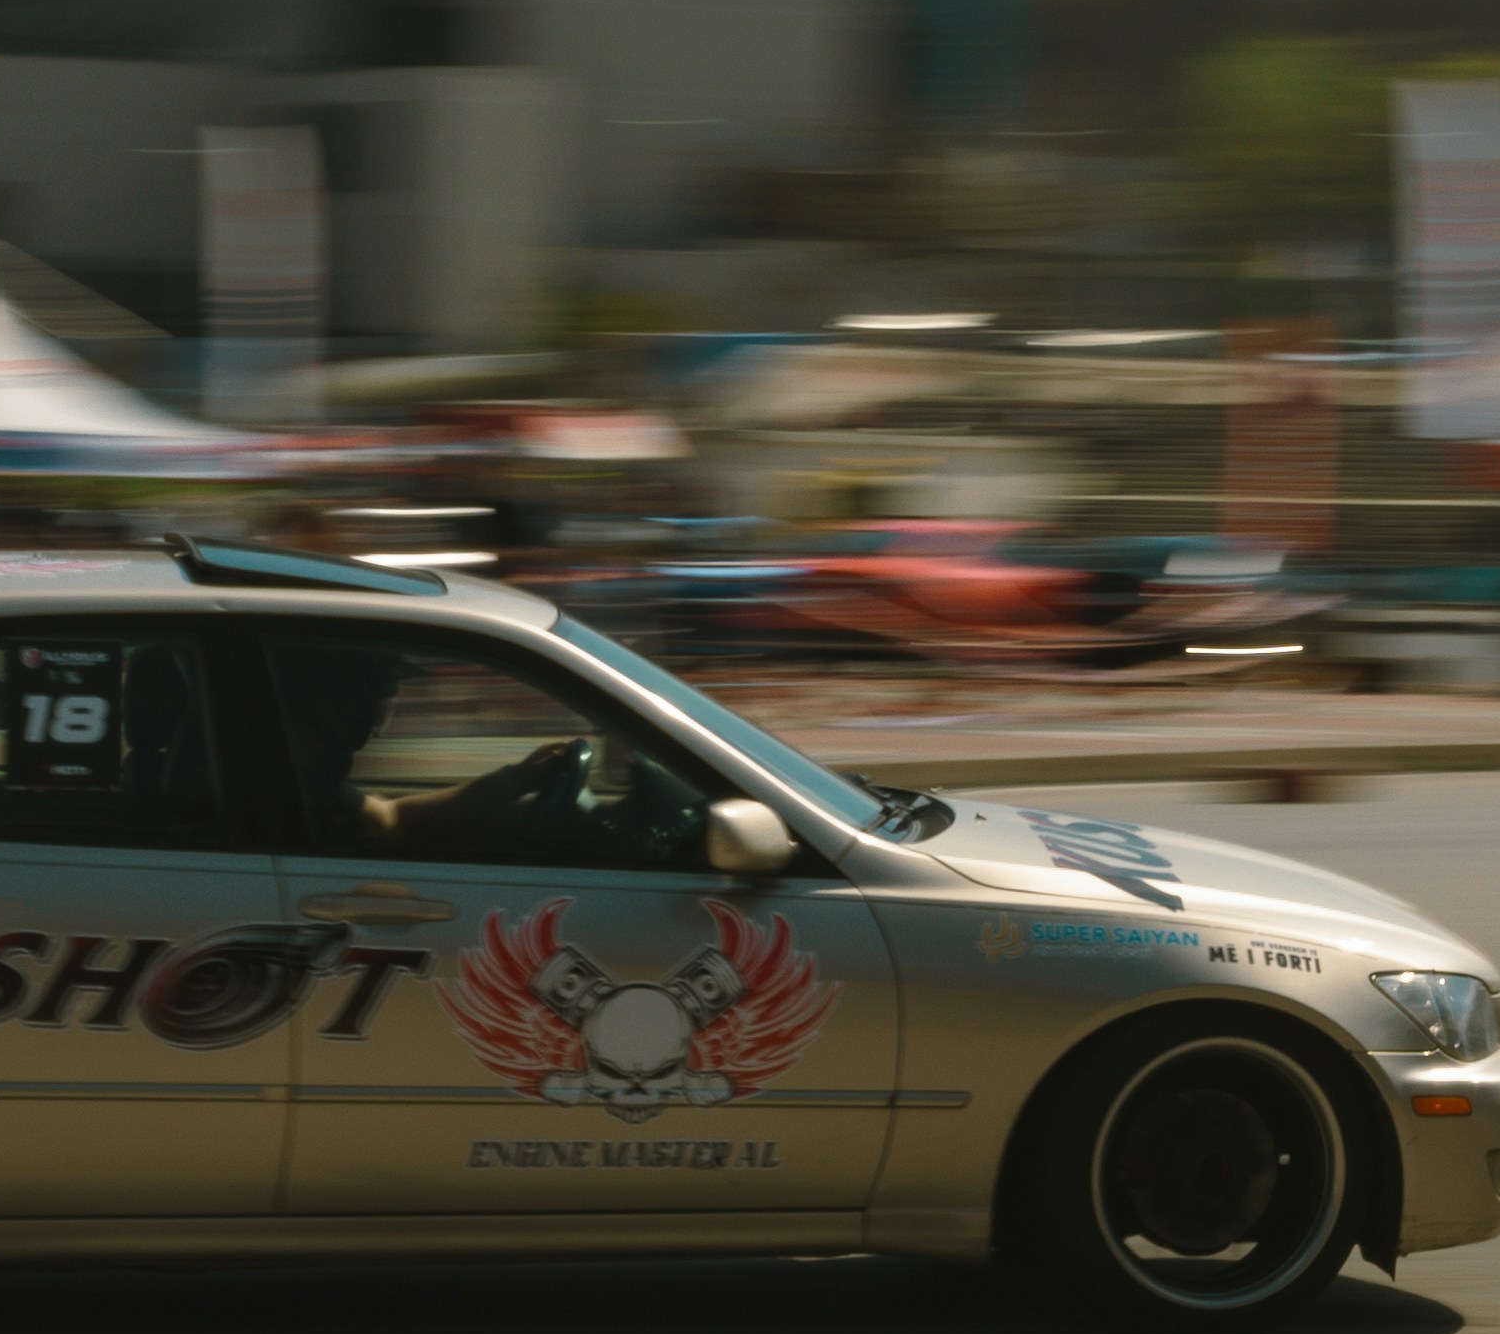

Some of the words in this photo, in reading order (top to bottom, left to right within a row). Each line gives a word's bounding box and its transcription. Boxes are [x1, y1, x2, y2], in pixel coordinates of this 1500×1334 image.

[22, 695, 110, 744] 18
[1031, 922, 1107, 944] SUPER
[1113, 926, 1199, 947] SAIYAN
[1247, 948, 1254, 965] I
[1264, 950, 1321, 974] FORTI
[467, 1140, 596, 1169] ENGINE
[598, 1140, 733, 1169] MASTER
[736, 1140, 781, 1169] AL
